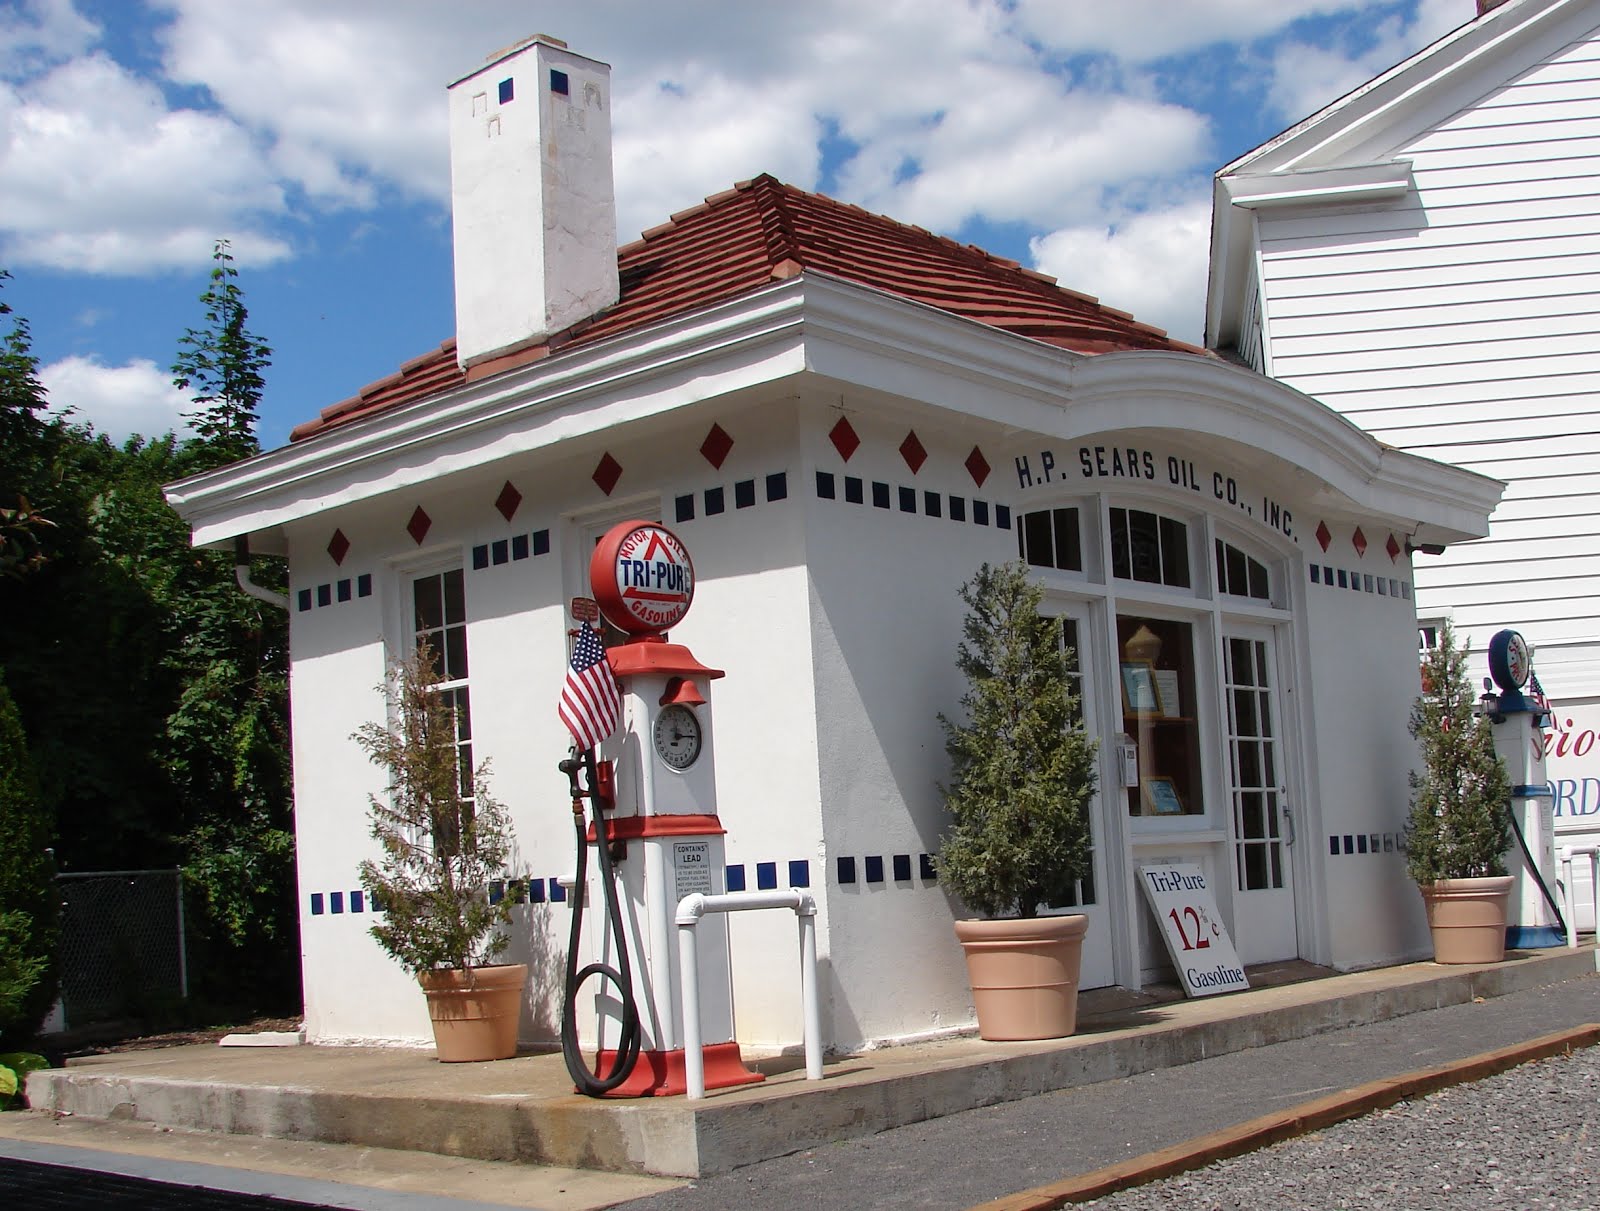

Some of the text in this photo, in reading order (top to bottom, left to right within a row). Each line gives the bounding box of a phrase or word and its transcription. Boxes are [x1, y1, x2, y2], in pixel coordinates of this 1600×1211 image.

[1015, 451, 1067, 488] H.P.
[1079, 446, 1155, 480] SEARS
[1168, 456, 1200, 491] OIL
[1264, 497, 1298, 542] INC.
[620, 530, 688, 563] MOTOR OILS
[620, 559, 690, 594] TRI-PURE
[631, 600, 682, 624] GASOLINE
[1146, 871, 1206, 892] Tri-Pure
[1187, 965, 1244, 989] Gasoline
